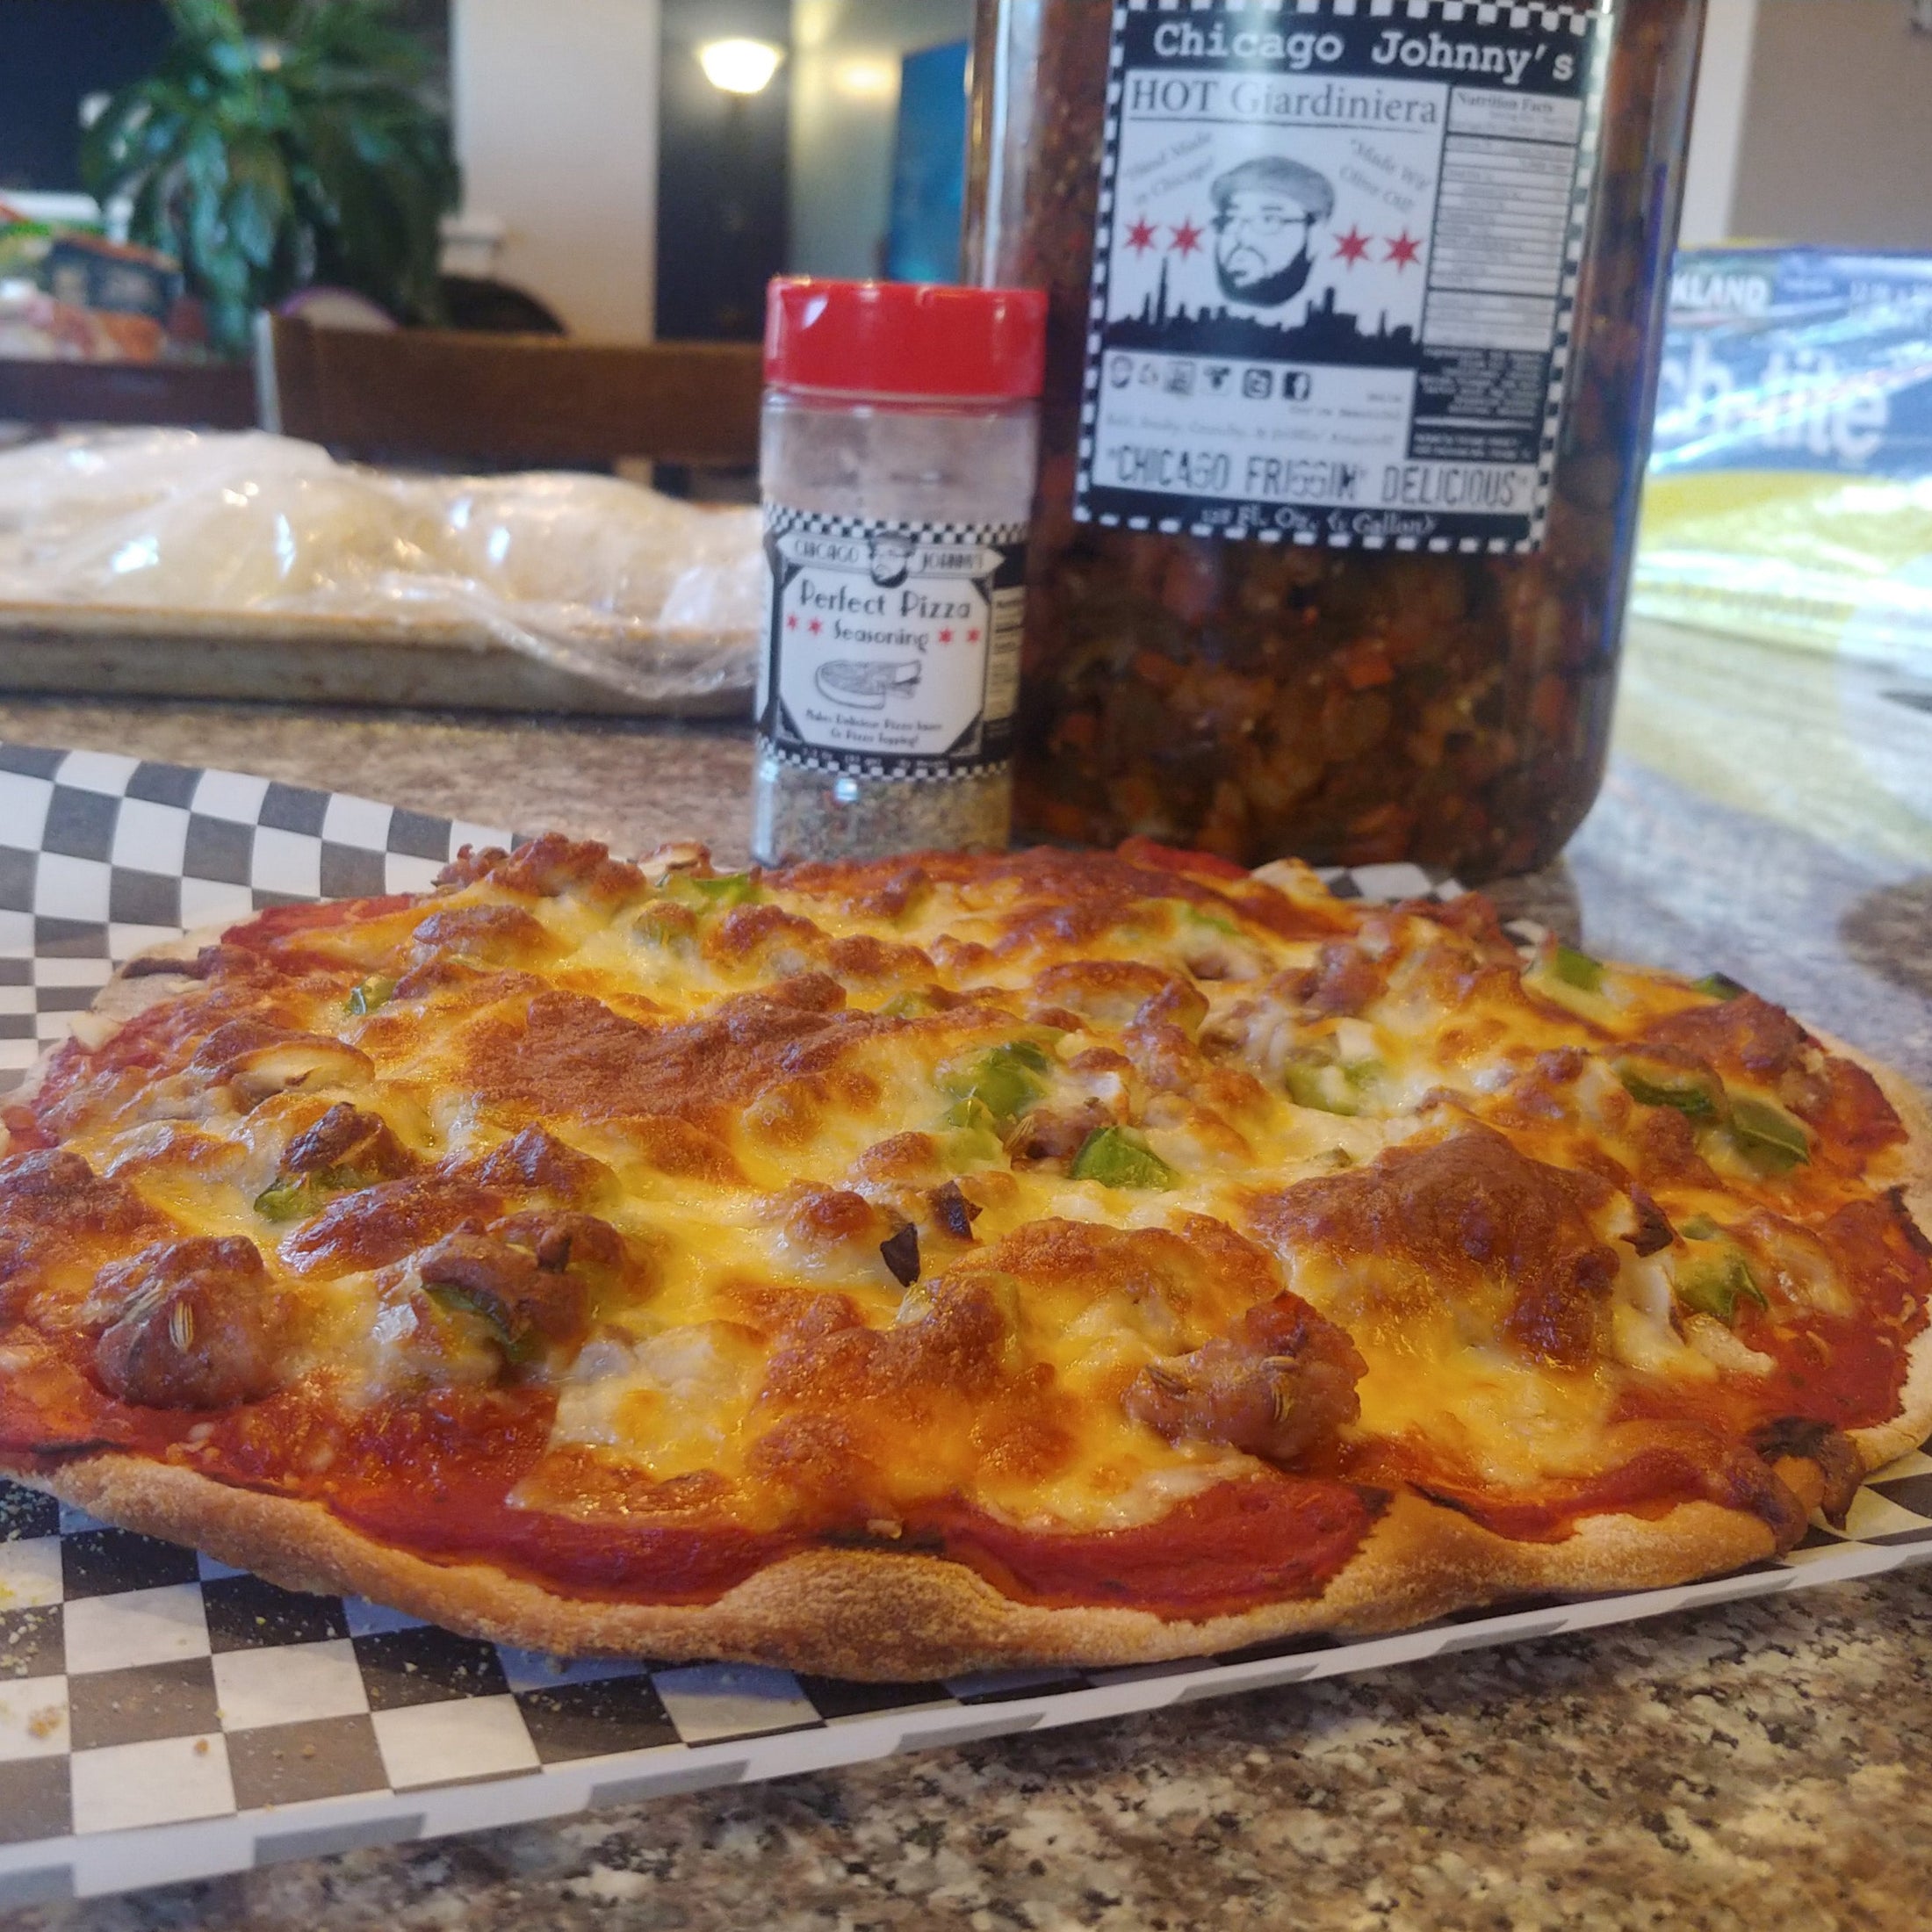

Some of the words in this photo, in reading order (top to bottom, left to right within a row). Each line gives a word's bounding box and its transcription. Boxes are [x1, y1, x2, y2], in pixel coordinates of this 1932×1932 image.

[1153, 21, 1344, 69] Chicago
[1371, 30, 1575, 85] Johnny's
[1132, 79, 1218, 112] HOT
[1231, 81, 1438, 124] Giardiniera
[794, 538, 859, 563] CHICAGO
[800, 579, 885, 615] Perfect
[900, 589, 970, 618] Pizza
[833, 618, 928, 653] Seasoning
